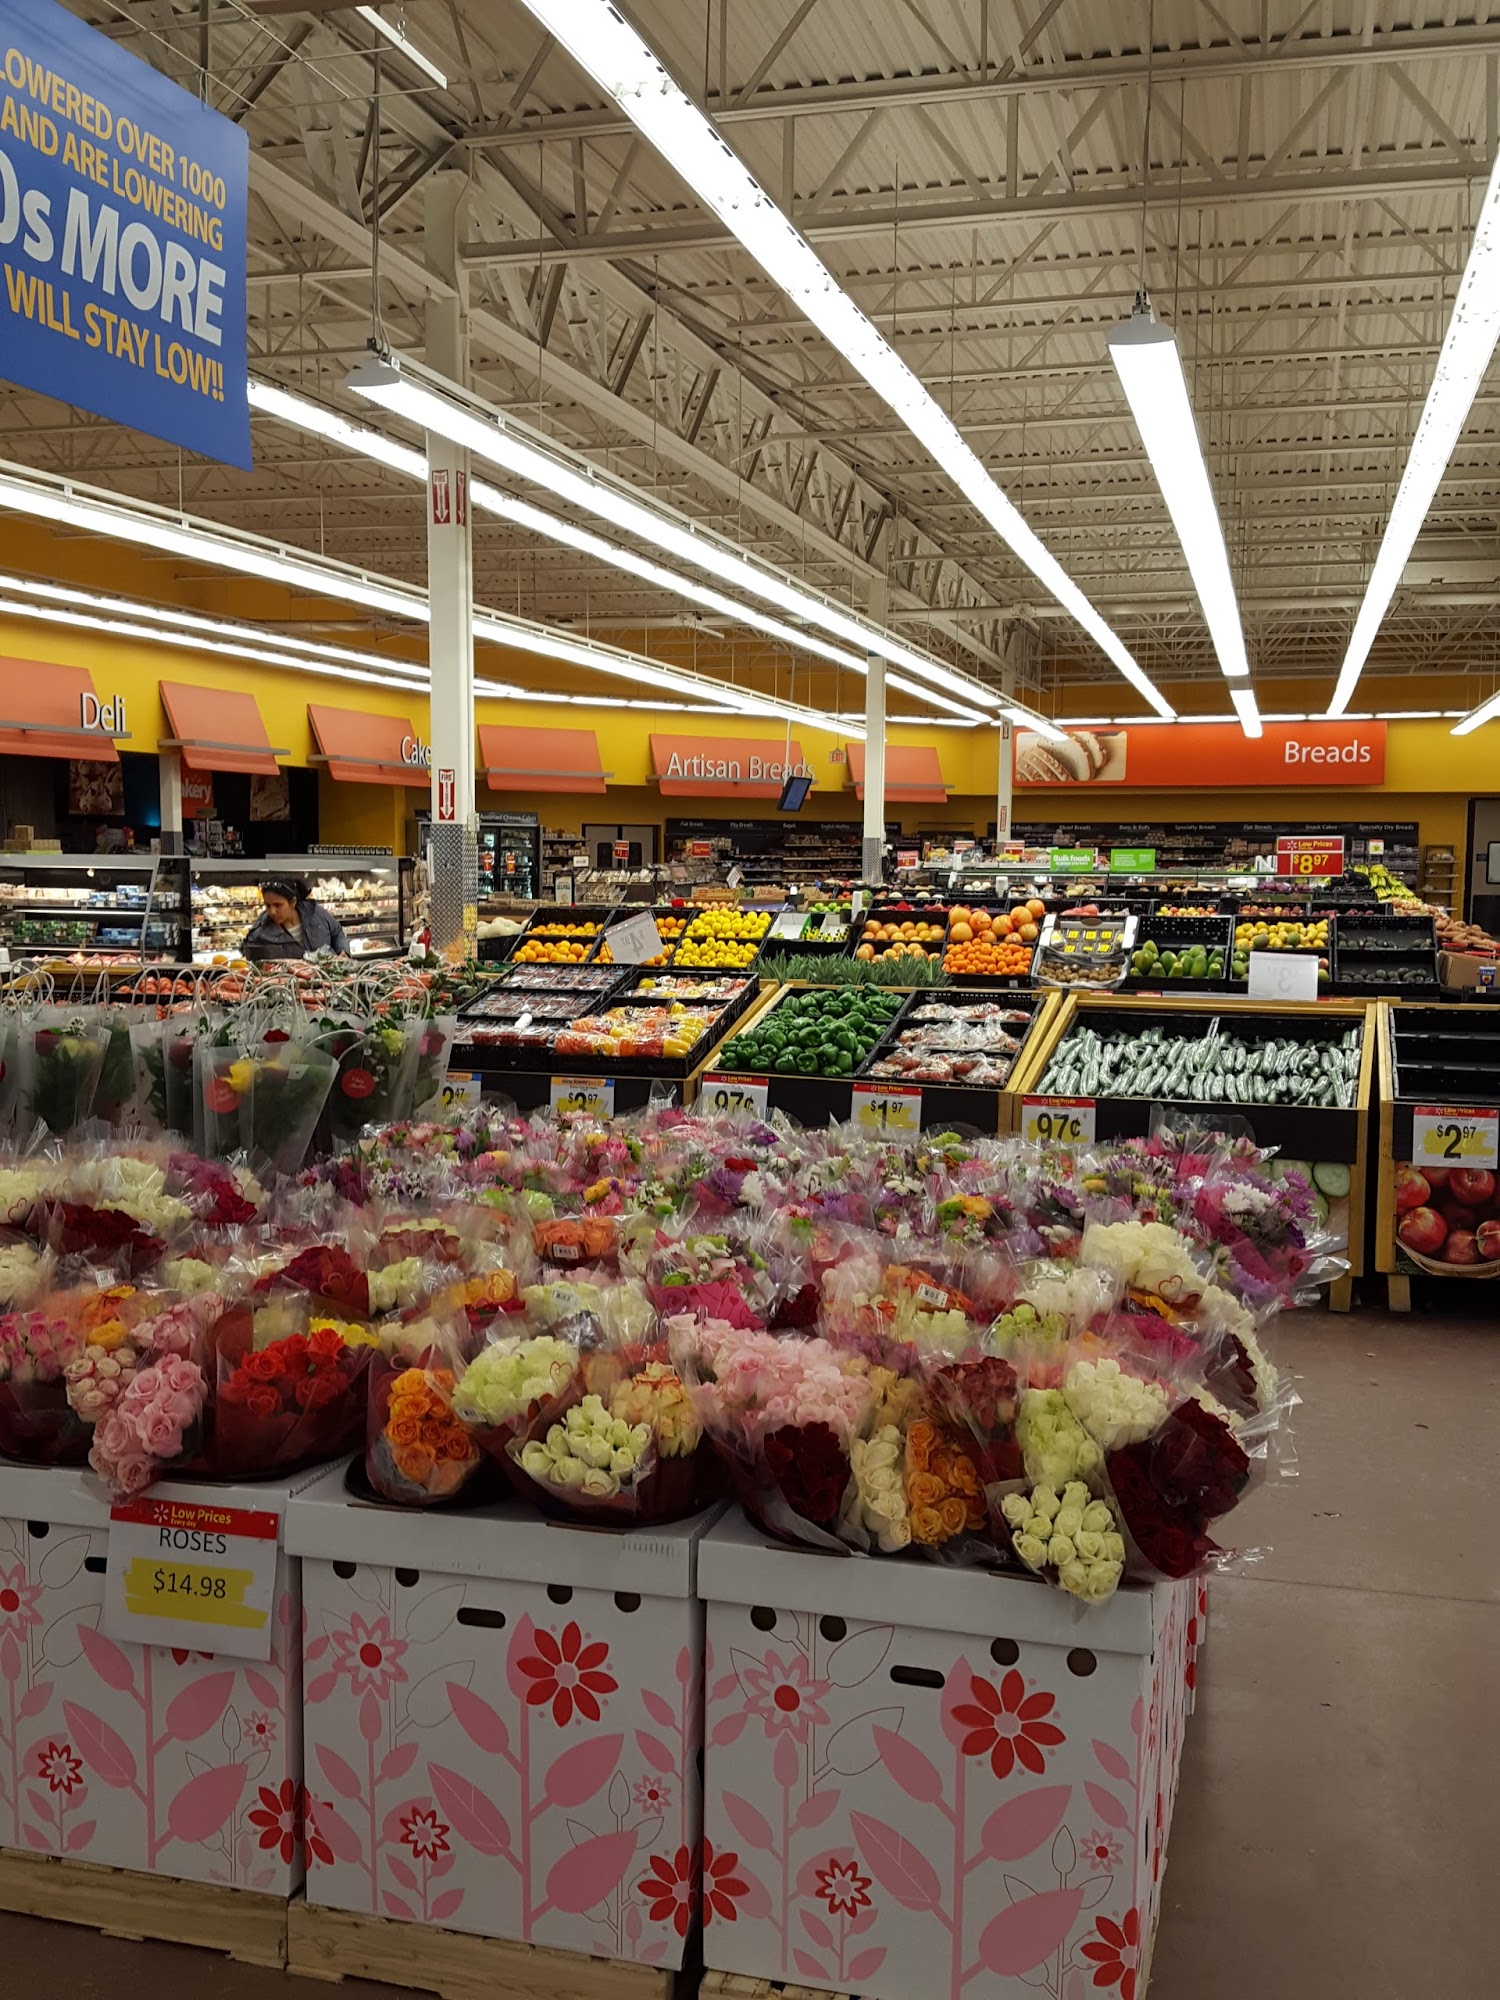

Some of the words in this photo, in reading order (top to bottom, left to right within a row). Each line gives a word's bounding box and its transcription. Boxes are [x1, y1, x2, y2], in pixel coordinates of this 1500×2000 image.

[0, 48, 112, 141] OWERED
[116, 117, 174, 181] OVER
[180, 156, 225, 210] 1000
[1, 95, 58, 156] AND
[62, 132, 109, 189] ARE
[113, 158, 222, 252] LOWERING
[61, 187, 226, 346] MORE
[4, 263, 80, 341] WILL
[84, 303, 149, 368] STAY
[155, 341, 224, 403] LOW!!
[80, 692, 126, 732] Deli
[1285, 739, 1371, 763] Breads
[441, 773, 452, 781] FIRE
[667, 752, 740, 778] Artisan
[749, 755, 815, 781] Breads
[1053, 854, 1069, 862] Bulk
[1070, 854, 1091, 862] foods
[1037, 1112, 1081, 1140] 97¢
[170, 1518, 185, 1527] Every
[186, 1520, 197, 1528] day
[171, 1506, 195, 1520] Low
[197, 1510, 232, 1525] Prices
[159, 1528, 227, 1554] ROSES
[153, 1568, 226, 1599] $14.98
